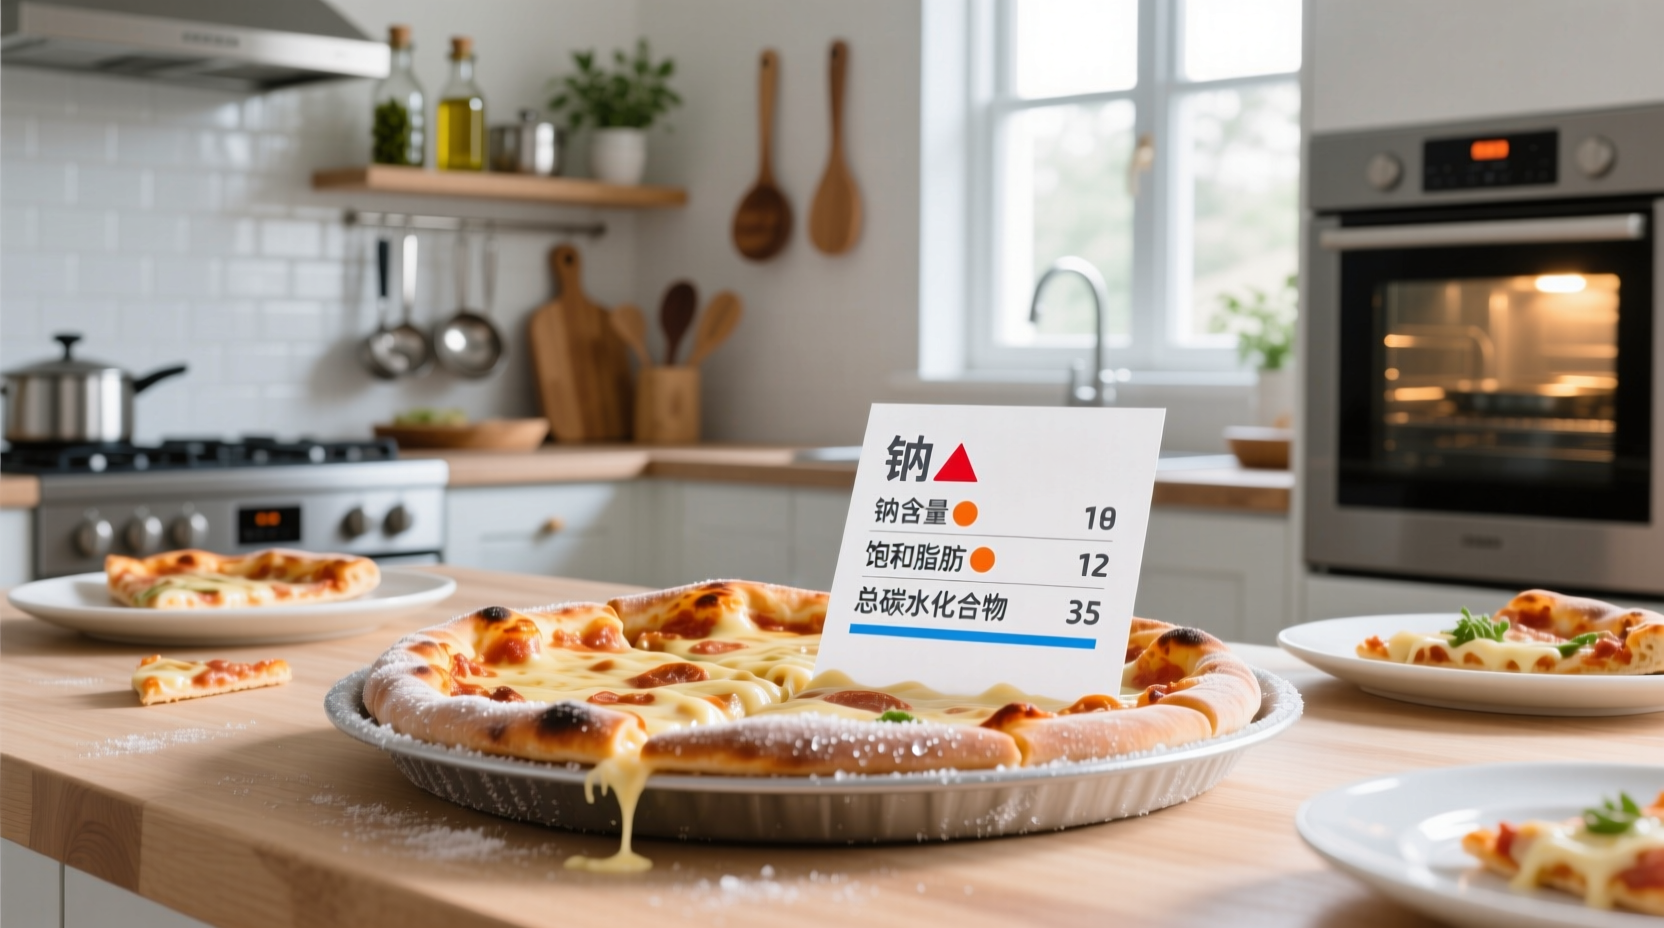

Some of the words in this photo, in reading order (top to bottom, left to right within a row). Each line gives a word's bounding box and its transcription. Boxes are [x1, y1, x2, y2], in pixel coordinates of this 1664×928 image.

[885, 435, 934, 482] 钠
[874, 497, 949, 525] 钠含量
[865, 540, 967, 573] 饱和脂肪
[1079, 553, 1109, 578] 12
[854, 586, 1008, 622] 总碳水化合物
[1065, 599, 1101, 626] 35
